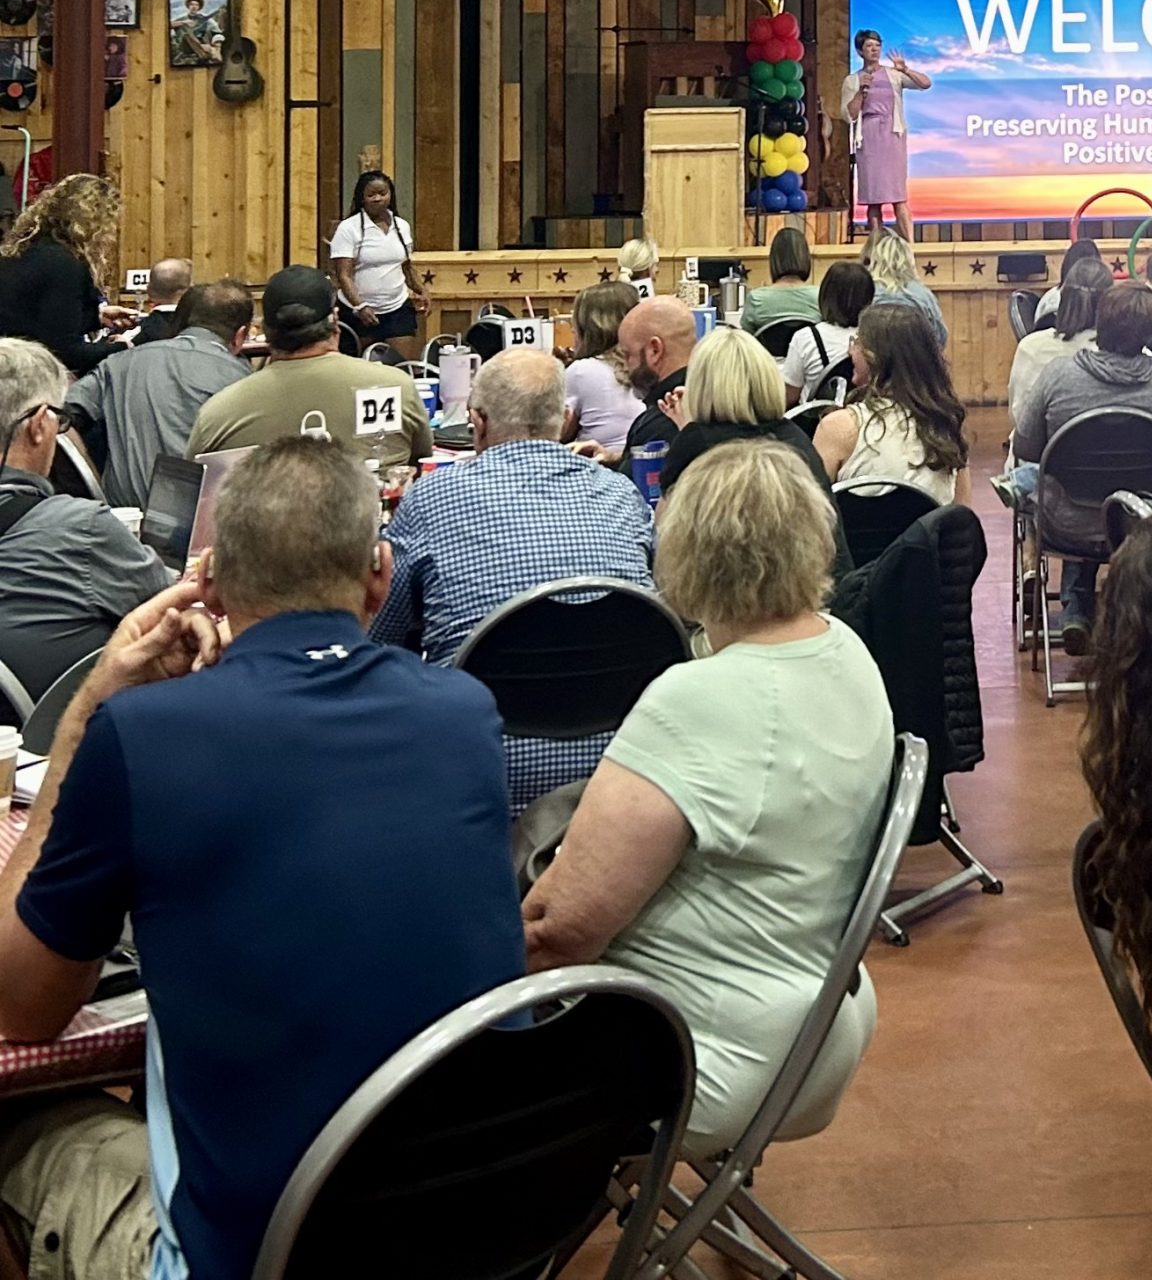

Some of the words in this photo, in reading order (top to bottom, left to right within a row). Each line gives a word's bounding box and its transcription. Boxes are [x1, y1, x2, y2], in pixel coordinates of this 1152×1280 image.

[1061, 84, 1107, 107] The
[966, 115, 1098, 140] Preserving
[132, 274, 148, 286] C1
[511, 325, 535, 346] D3
[362, 396, 396, 424] D4
